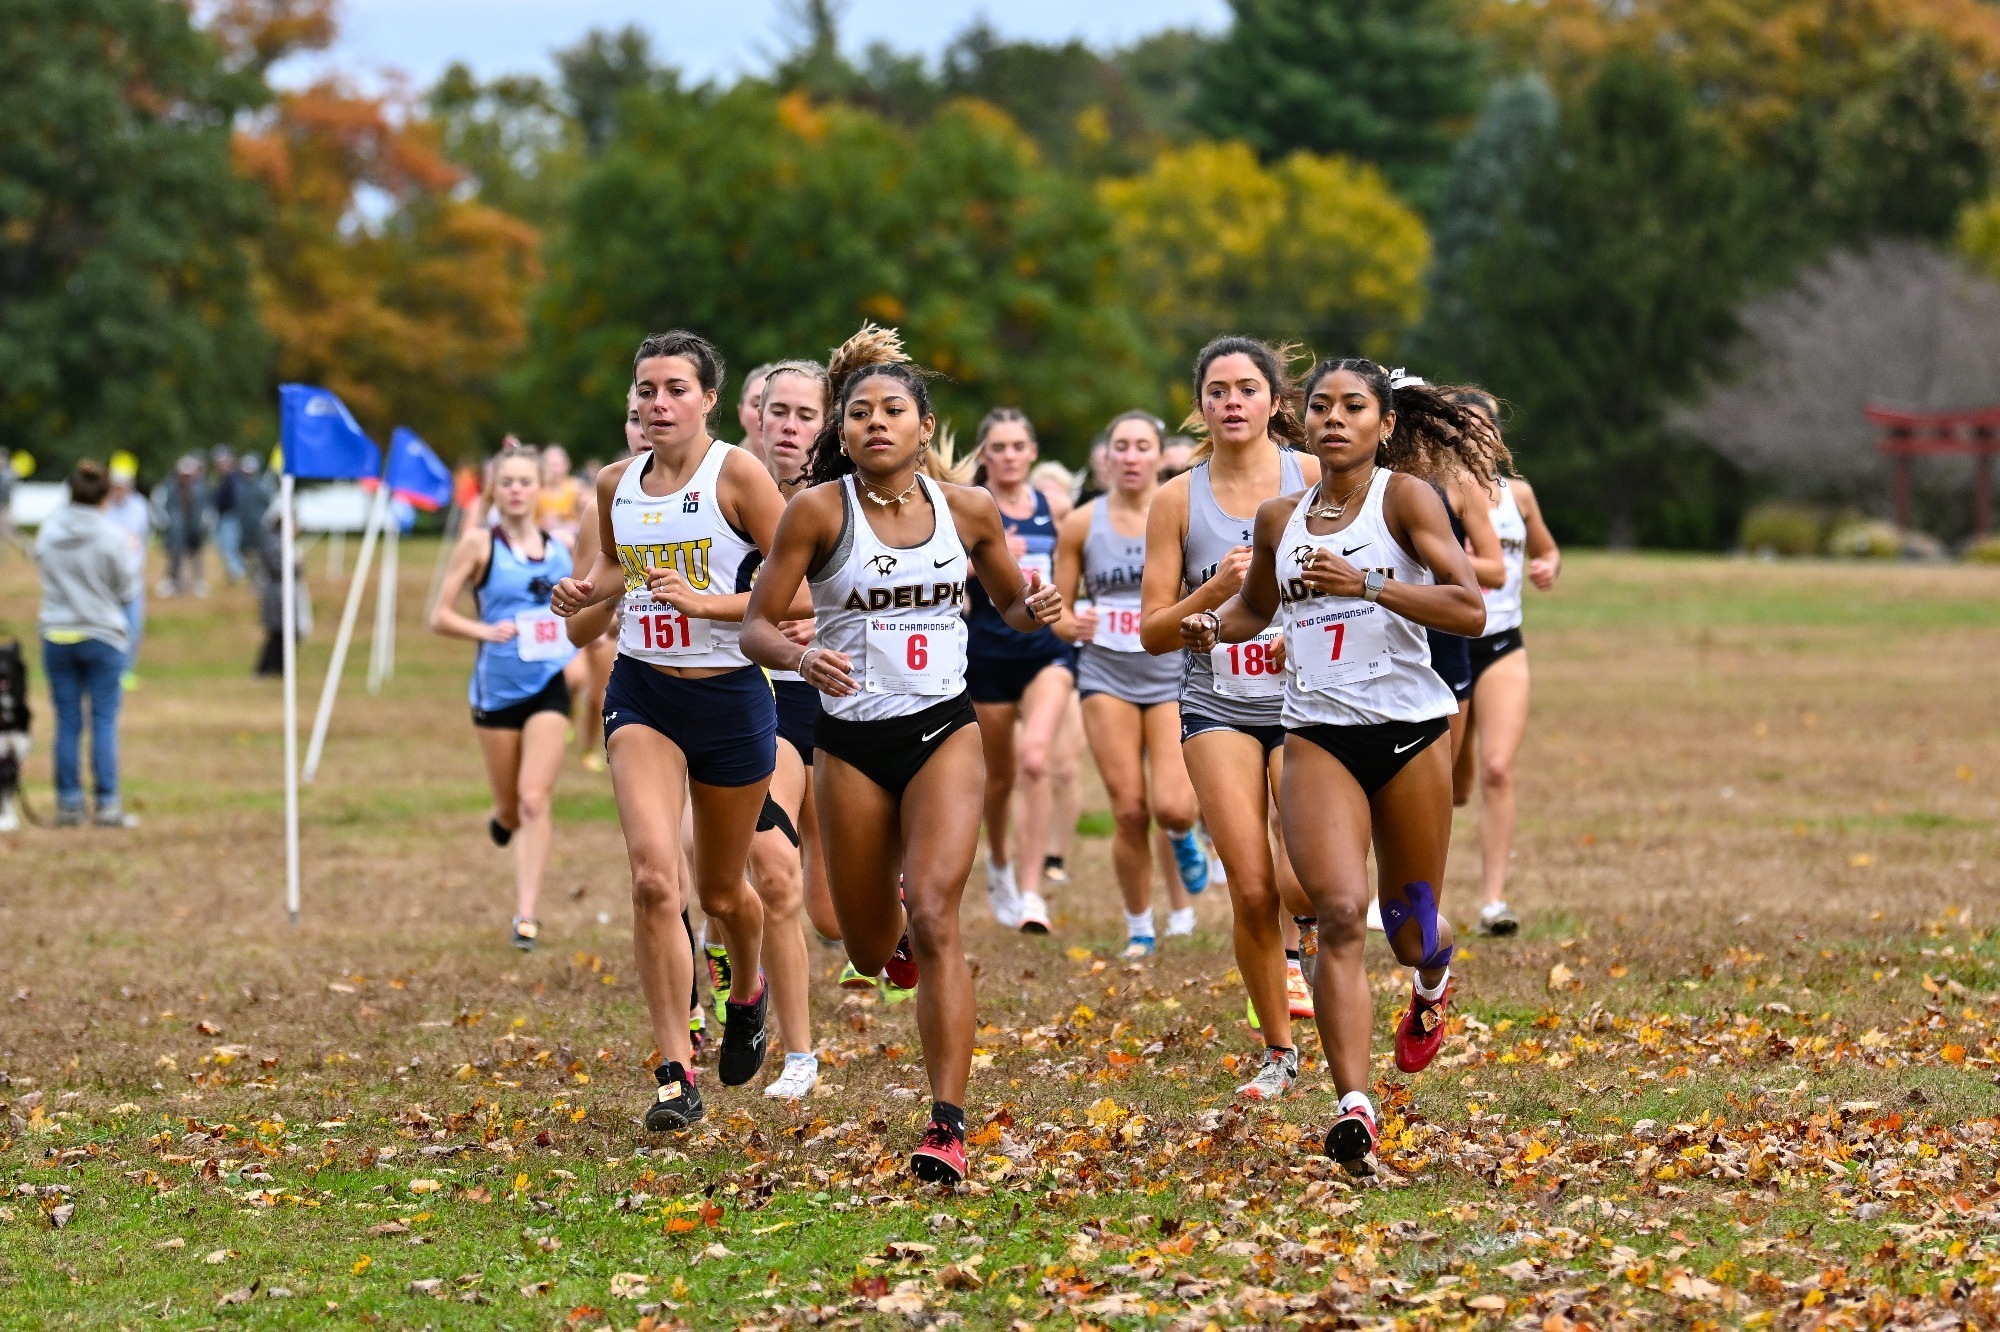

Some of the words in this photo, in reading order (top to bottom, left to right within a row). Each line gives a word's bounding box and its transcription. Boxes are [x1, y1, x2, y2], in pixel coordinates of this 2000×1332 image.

[682, 502, 699, 513] 10
[843, 580, 966, 611] ADELPH
[638, 613, 690, 648] 151
[900, 622, 955, 631] CHAMPIONSHIP
[1316, 606, 1375, 624] CHAMPIONSHIP
[907, 634, 928, 670] 6
[1324, 623, 1345, 661] 7
[1226, 643, 1284, 676] 185
